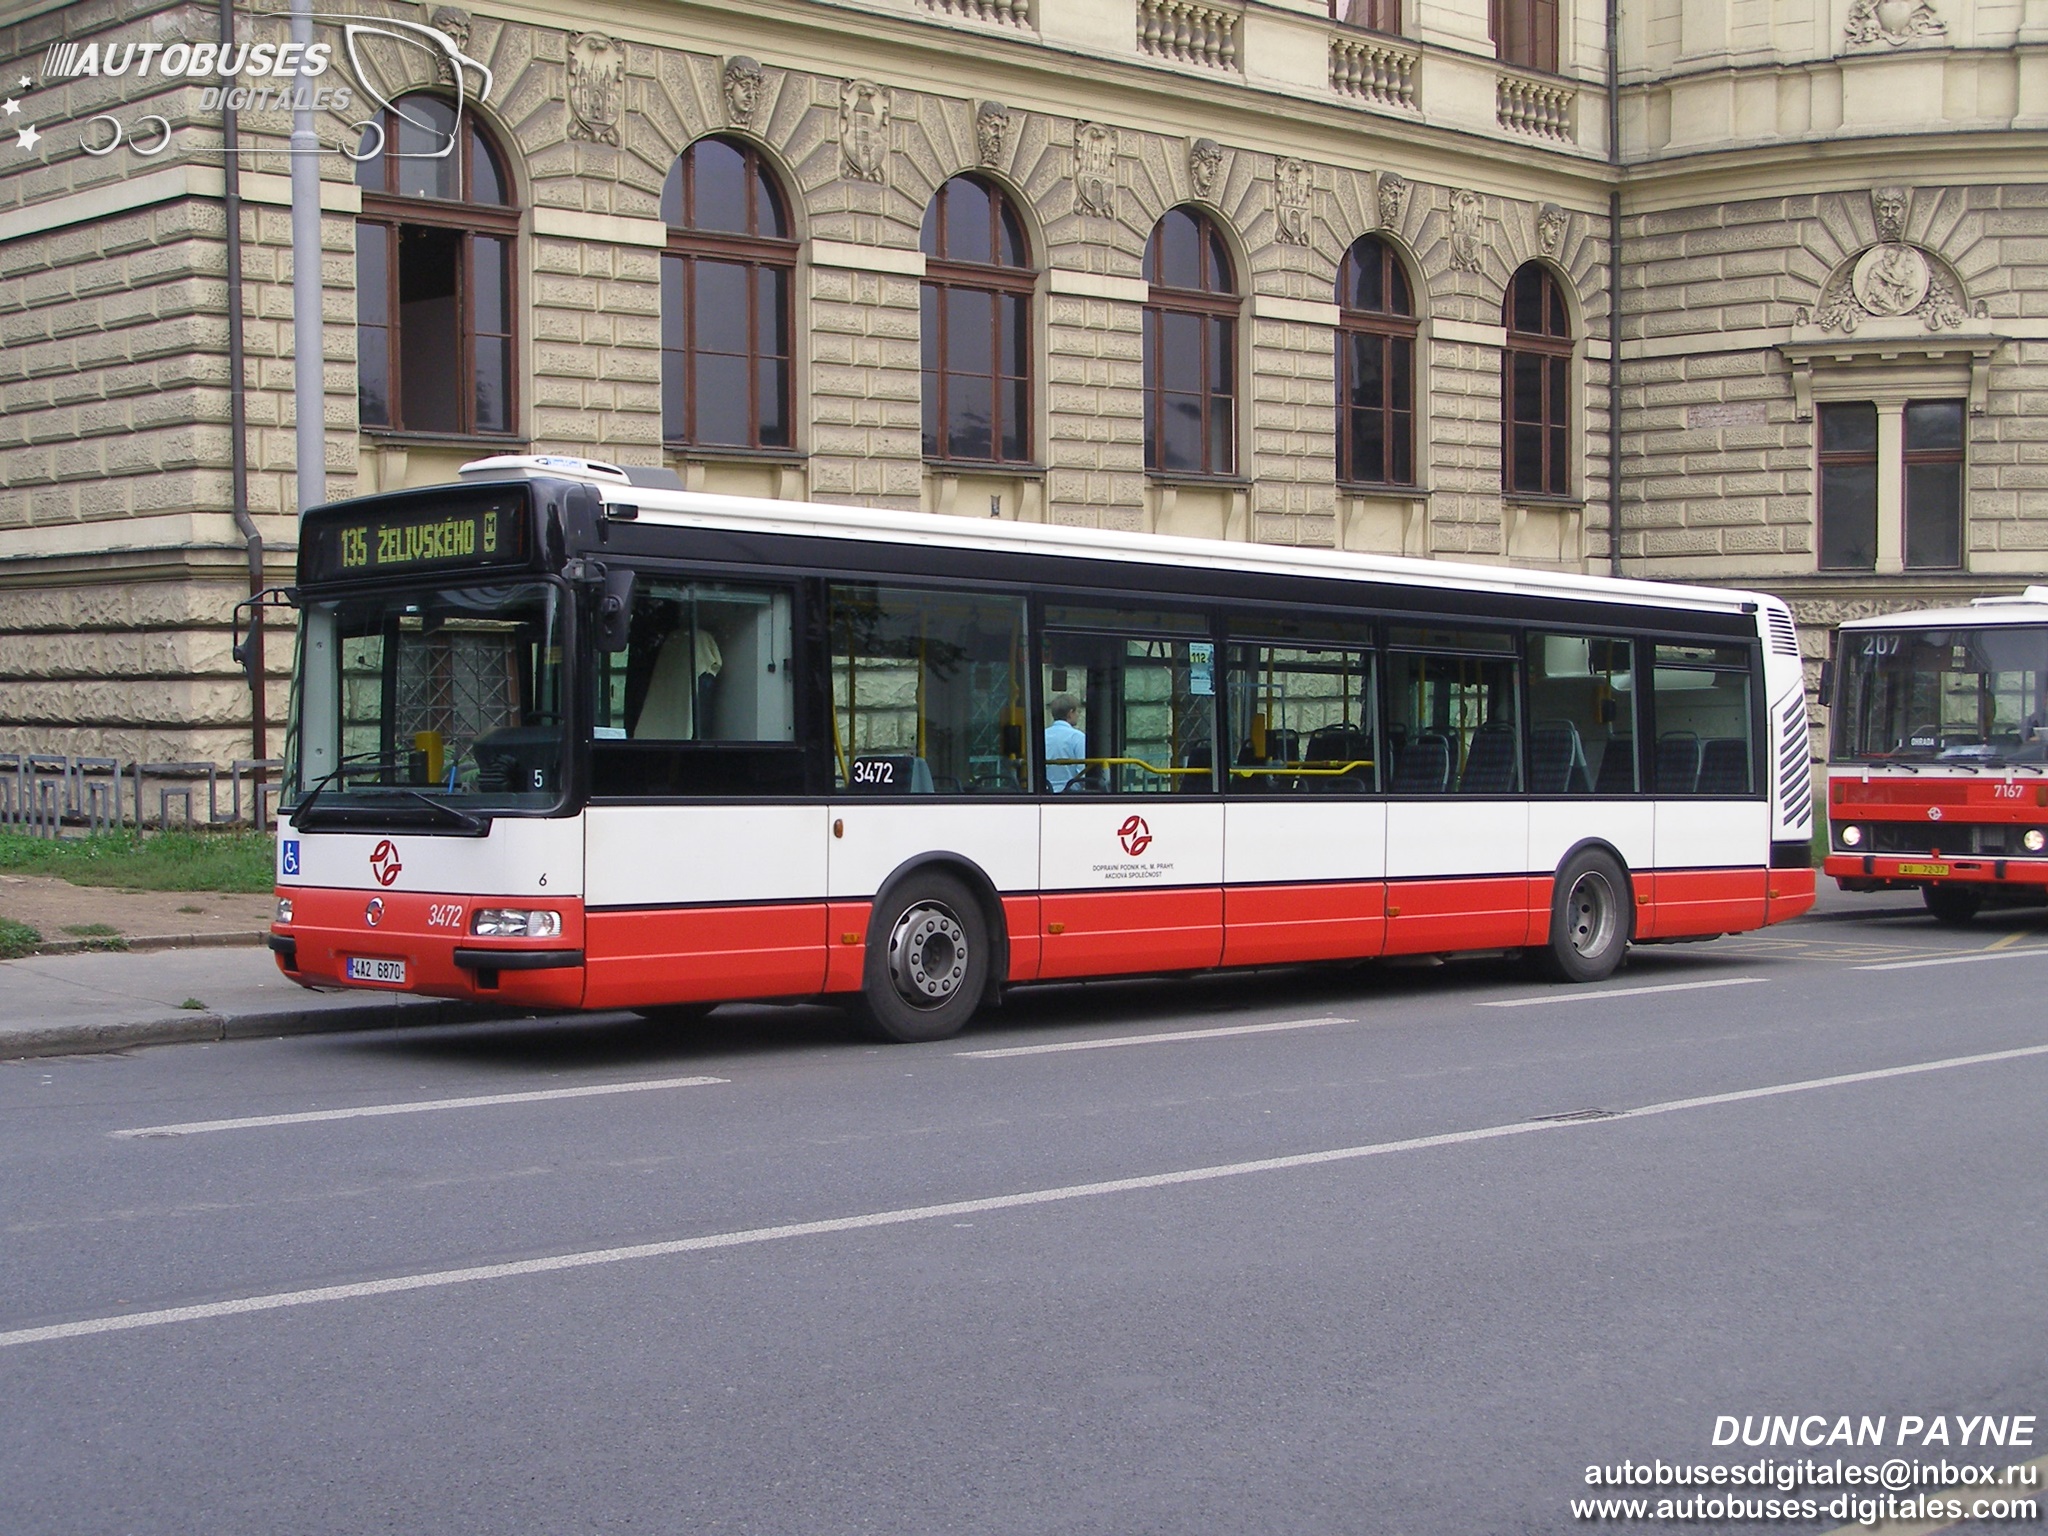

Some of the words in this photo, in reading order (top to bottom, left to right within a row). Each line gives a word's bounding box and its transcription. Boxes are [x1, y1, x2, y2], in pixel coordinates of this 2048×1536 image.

[341, 526, 368, 567] 135
[377, 517, 475, 564] ŽELIVSKÉHO
[1863, 635, 1900, 655] 207
[1191, 652, 1206, 664] 112
[533, 769, 543, 788] 5
[854, 761, 894, 783] 3472
[1993, 784, 2023, 798] 7167
[538, 872, 548, 887] 6
[1128, 870, 1162, 878] SPOLEČNOST
[428, 904, 463, 927] 3472
[354, 960, 372, 977] 4A2
[377, 962, 401, 980] 6870
